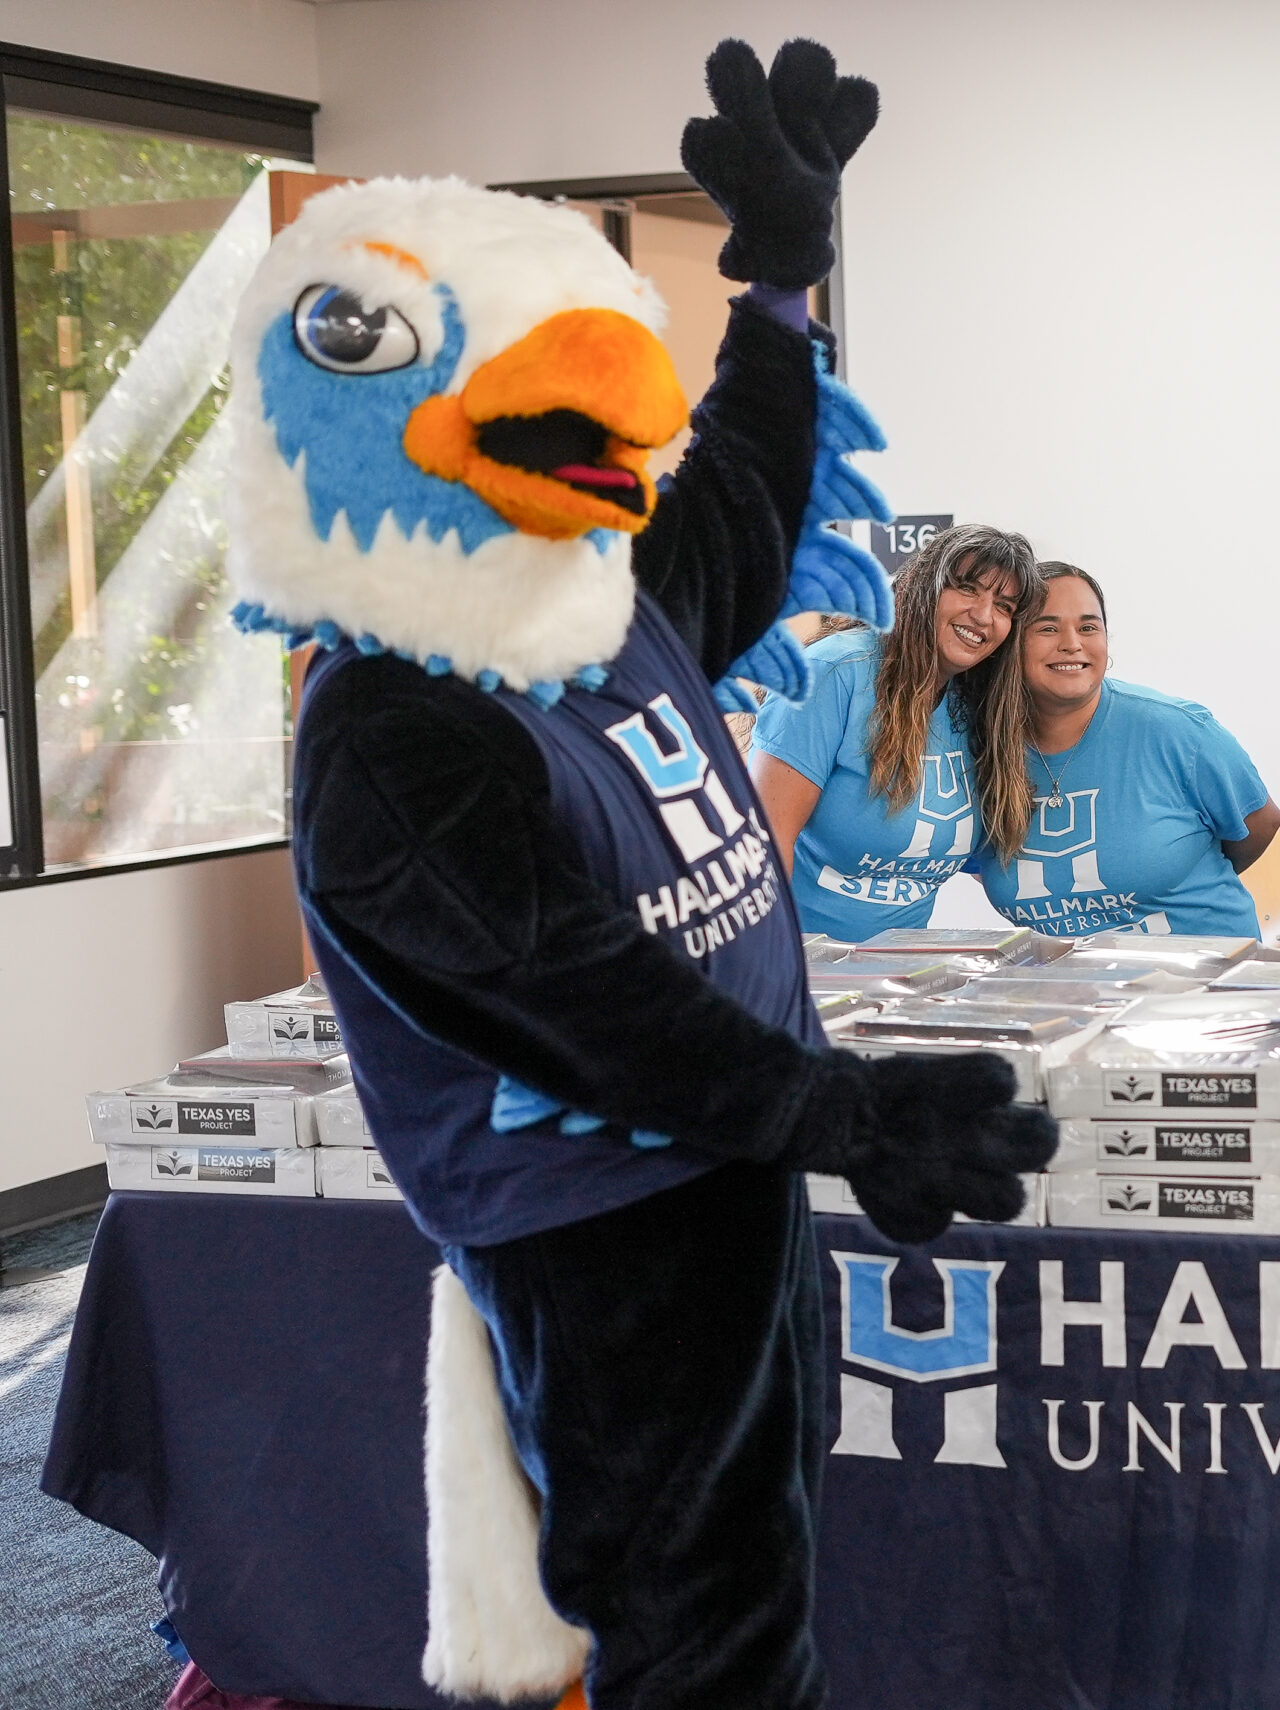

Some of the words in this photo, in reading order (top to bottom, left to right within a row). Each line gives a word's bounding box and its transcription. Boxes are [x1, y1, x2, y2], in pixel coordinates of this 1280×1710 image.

[999, 892, 1138, 921] HALLMARK
[318, 1021, 342, 1033] TEX
[1166, 1078, 1219, 1093] TEXAS
[1221, 1079, 1252, 1093] YES
[1188, 1093, 1230, 1102] PROJECT
[182, 1107, 223, 1121] TEXAS
[225, 1108, 251, 1121] YES
[200, 1121, 233, 1130] PROJECT
[1160, 1132, 1212, 1147] TEXAS
[1214, 1133, 1246, 1148] YES
[1182, 1147, 1224, 1157] PROJECT
[203, 1154, 244, 1168] TEXAS
[246, 1156, 271, 1168] YES
[219, 1168, 253, 1177] PROJECT
[1164, 1188, 1216, 1203] TEXAS
[1217, 1190, 1249, 1205] YES
[1185, 1203, 1226, 1213] PROJECT
